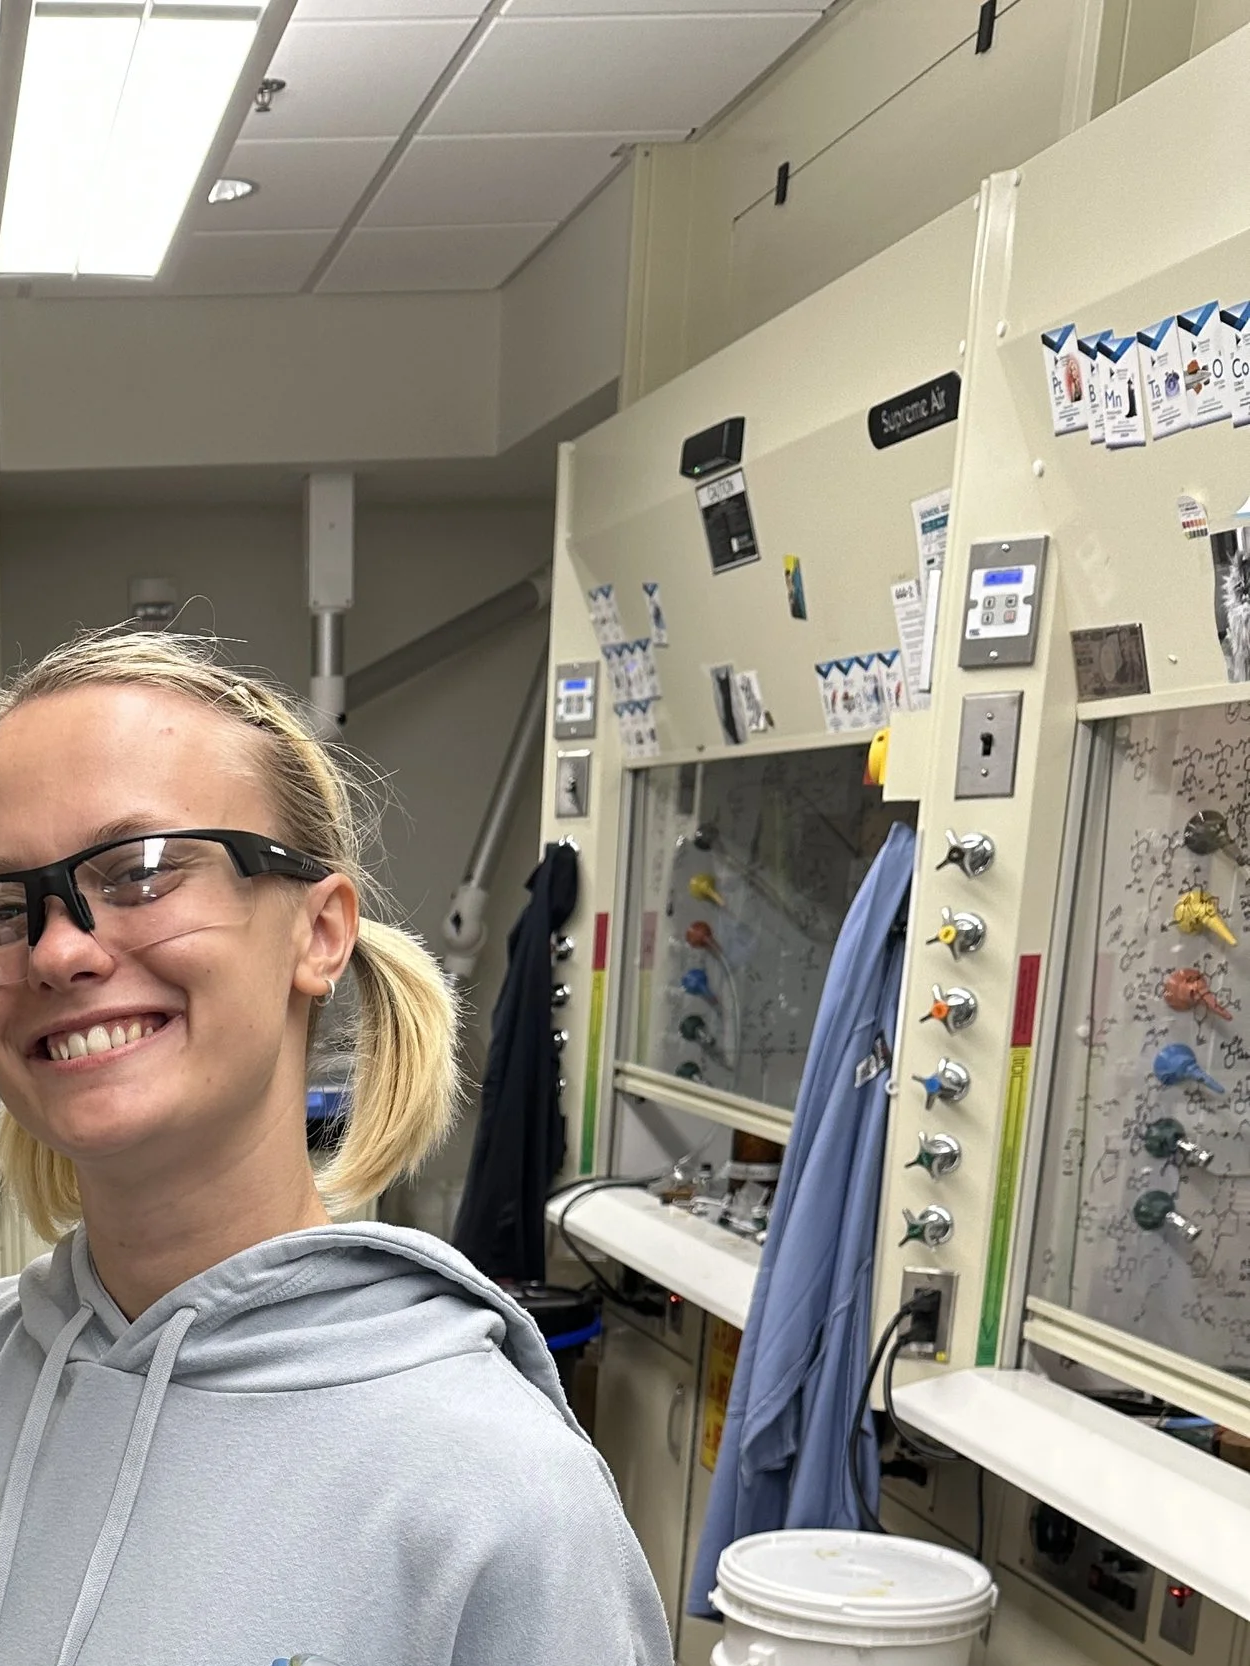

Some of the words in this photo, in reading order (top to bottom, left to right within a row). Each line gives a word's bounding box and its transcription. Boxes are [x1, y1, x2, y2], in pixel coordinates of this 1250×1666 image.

[1232, 358, 1250, 378] Co
[1148, 379, 1162, 399] Ta
[881, 399, 929, 434] Supreme
[931, 385, 946, 413] Air
[1105, 390, 1122, 409] Mn
